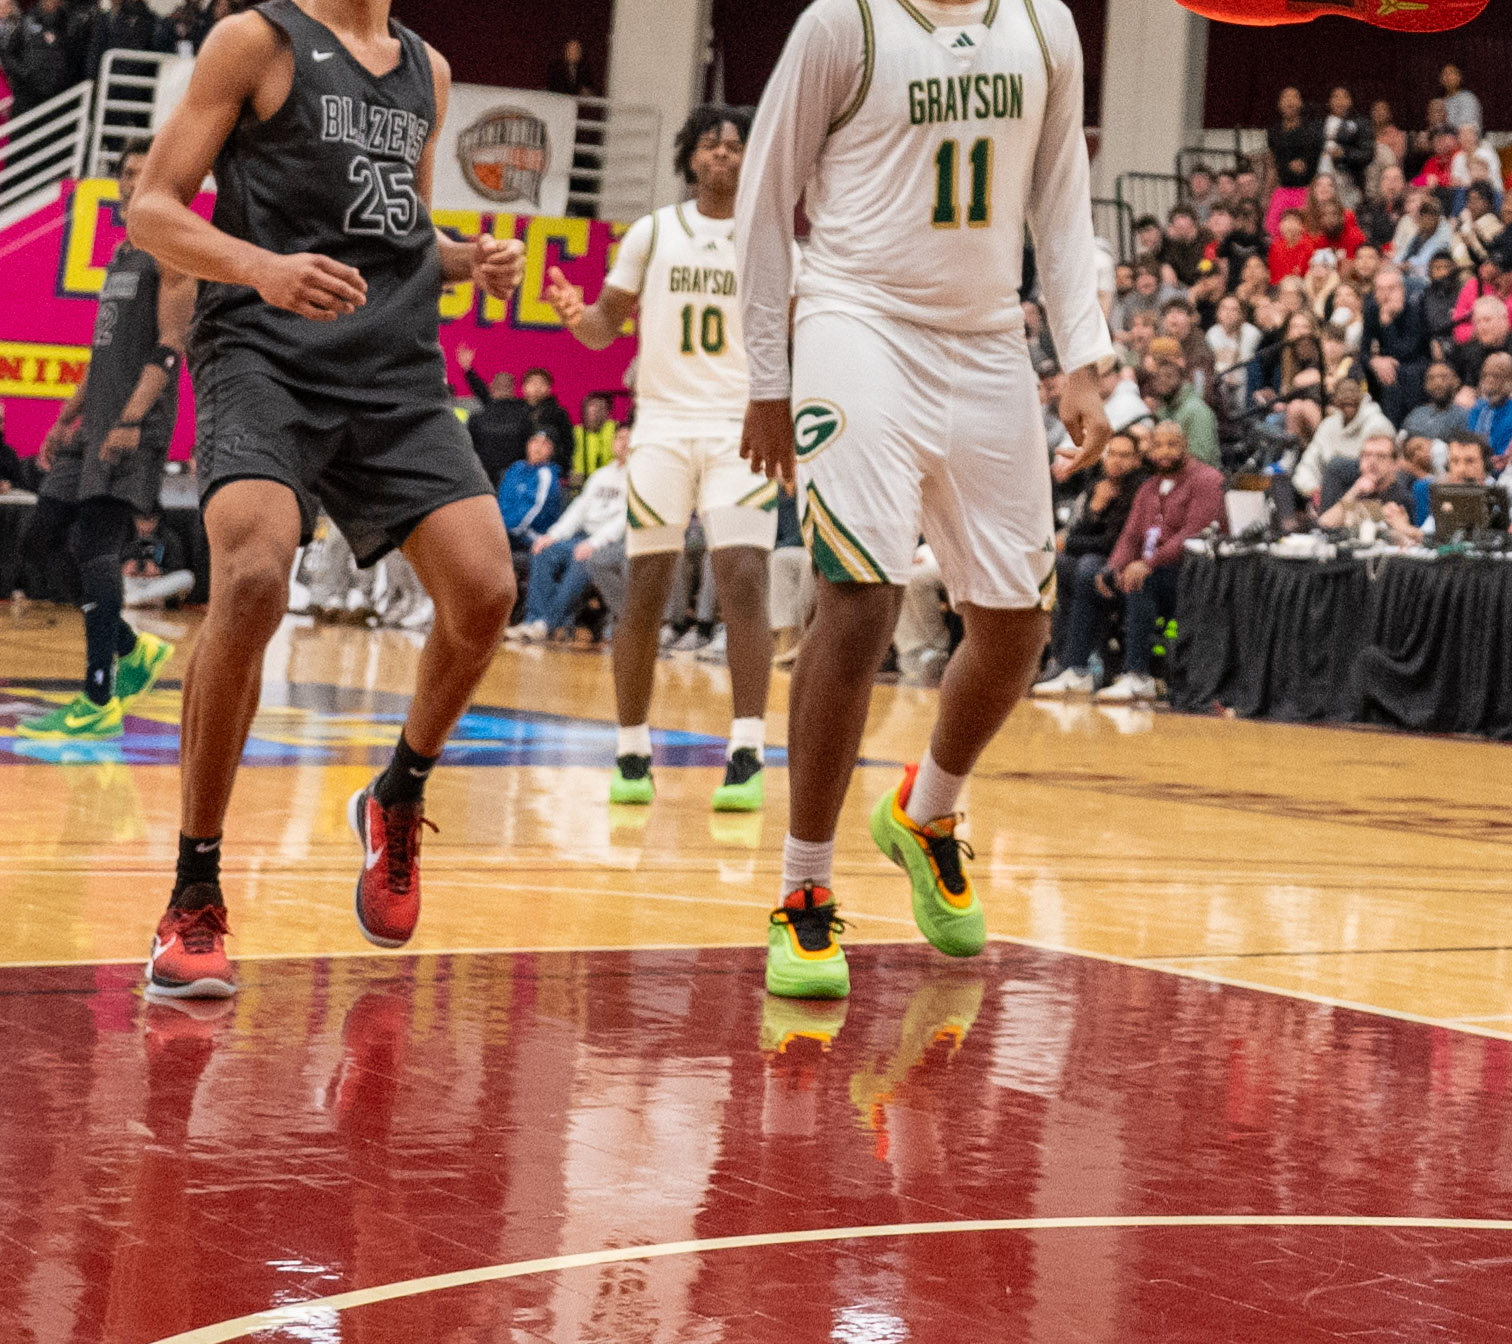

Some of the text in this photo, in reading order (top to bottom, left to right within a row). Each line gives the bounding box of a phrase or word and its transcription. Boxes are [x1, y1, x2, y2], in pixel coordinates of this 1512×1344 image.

[908, 72, 1023, 125] GRAYSON
[343, 155, 418, 236] 25
[930, 135, 995, 230] 11
[679, 303, 728, 357] 10
[795, 404, 839, 457] G
